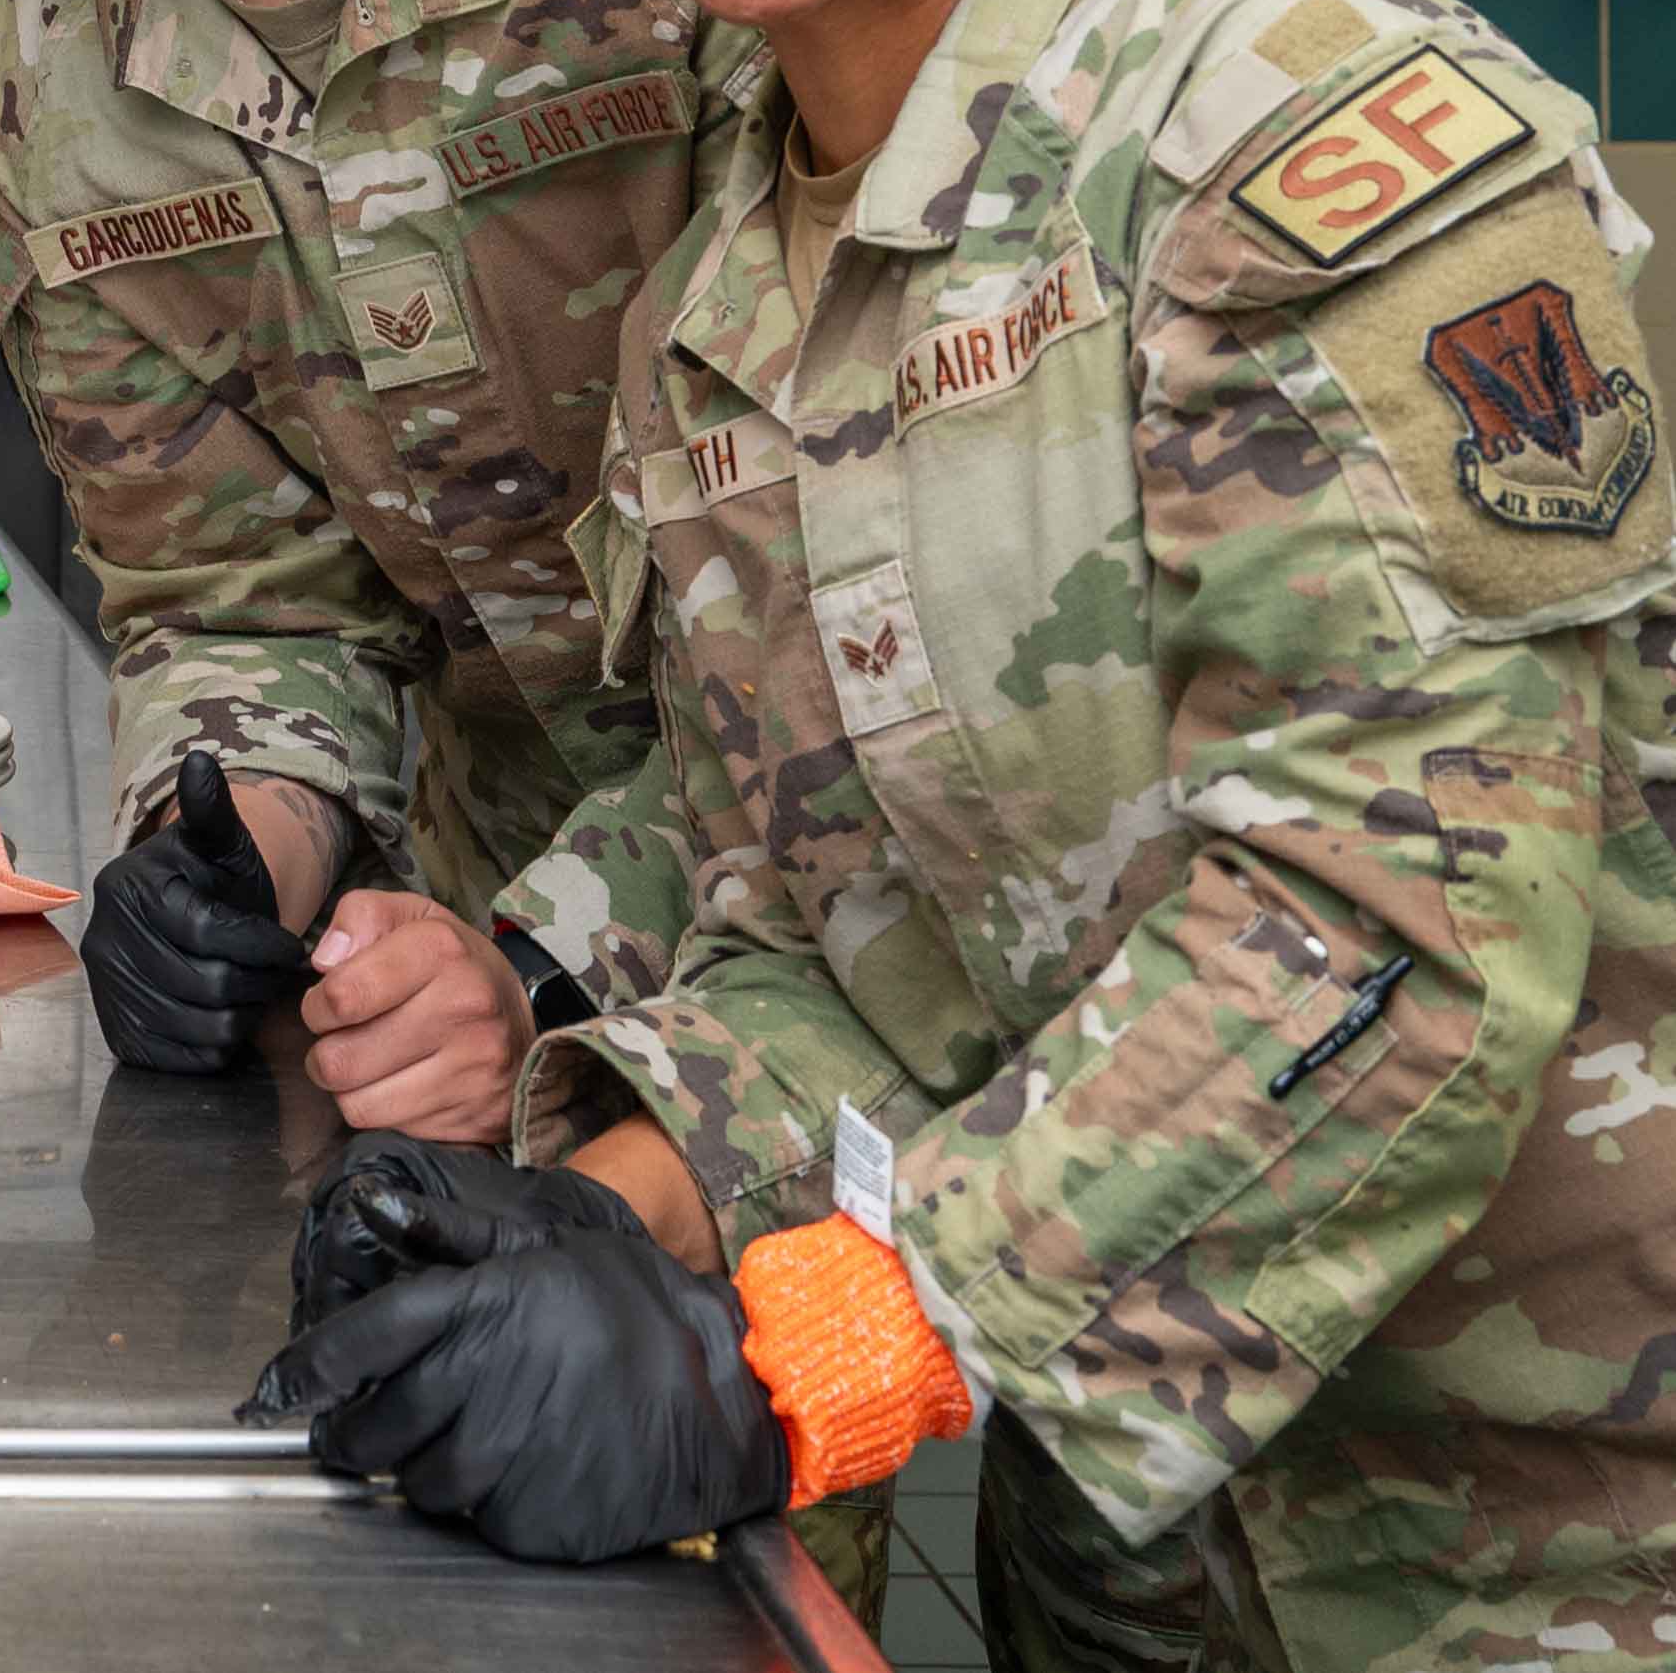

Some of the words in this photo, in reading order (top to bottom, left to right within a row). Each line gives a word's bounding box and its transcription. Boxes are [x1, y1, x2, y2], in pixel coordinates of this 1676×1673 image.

[440, 130, 522, 188] U.S.
[518, 105, 587, 165] AIR
[577, 82, 676, 143] FORCE
[1278, 69, 1459, 230] SF
[58, 191, 254, 272] GARCIDUENAS
[934, 327, 997, 399] AIR
[1003, 262, 1077, 374] FORCE
[1497, 490, 1530, 518] AIR
